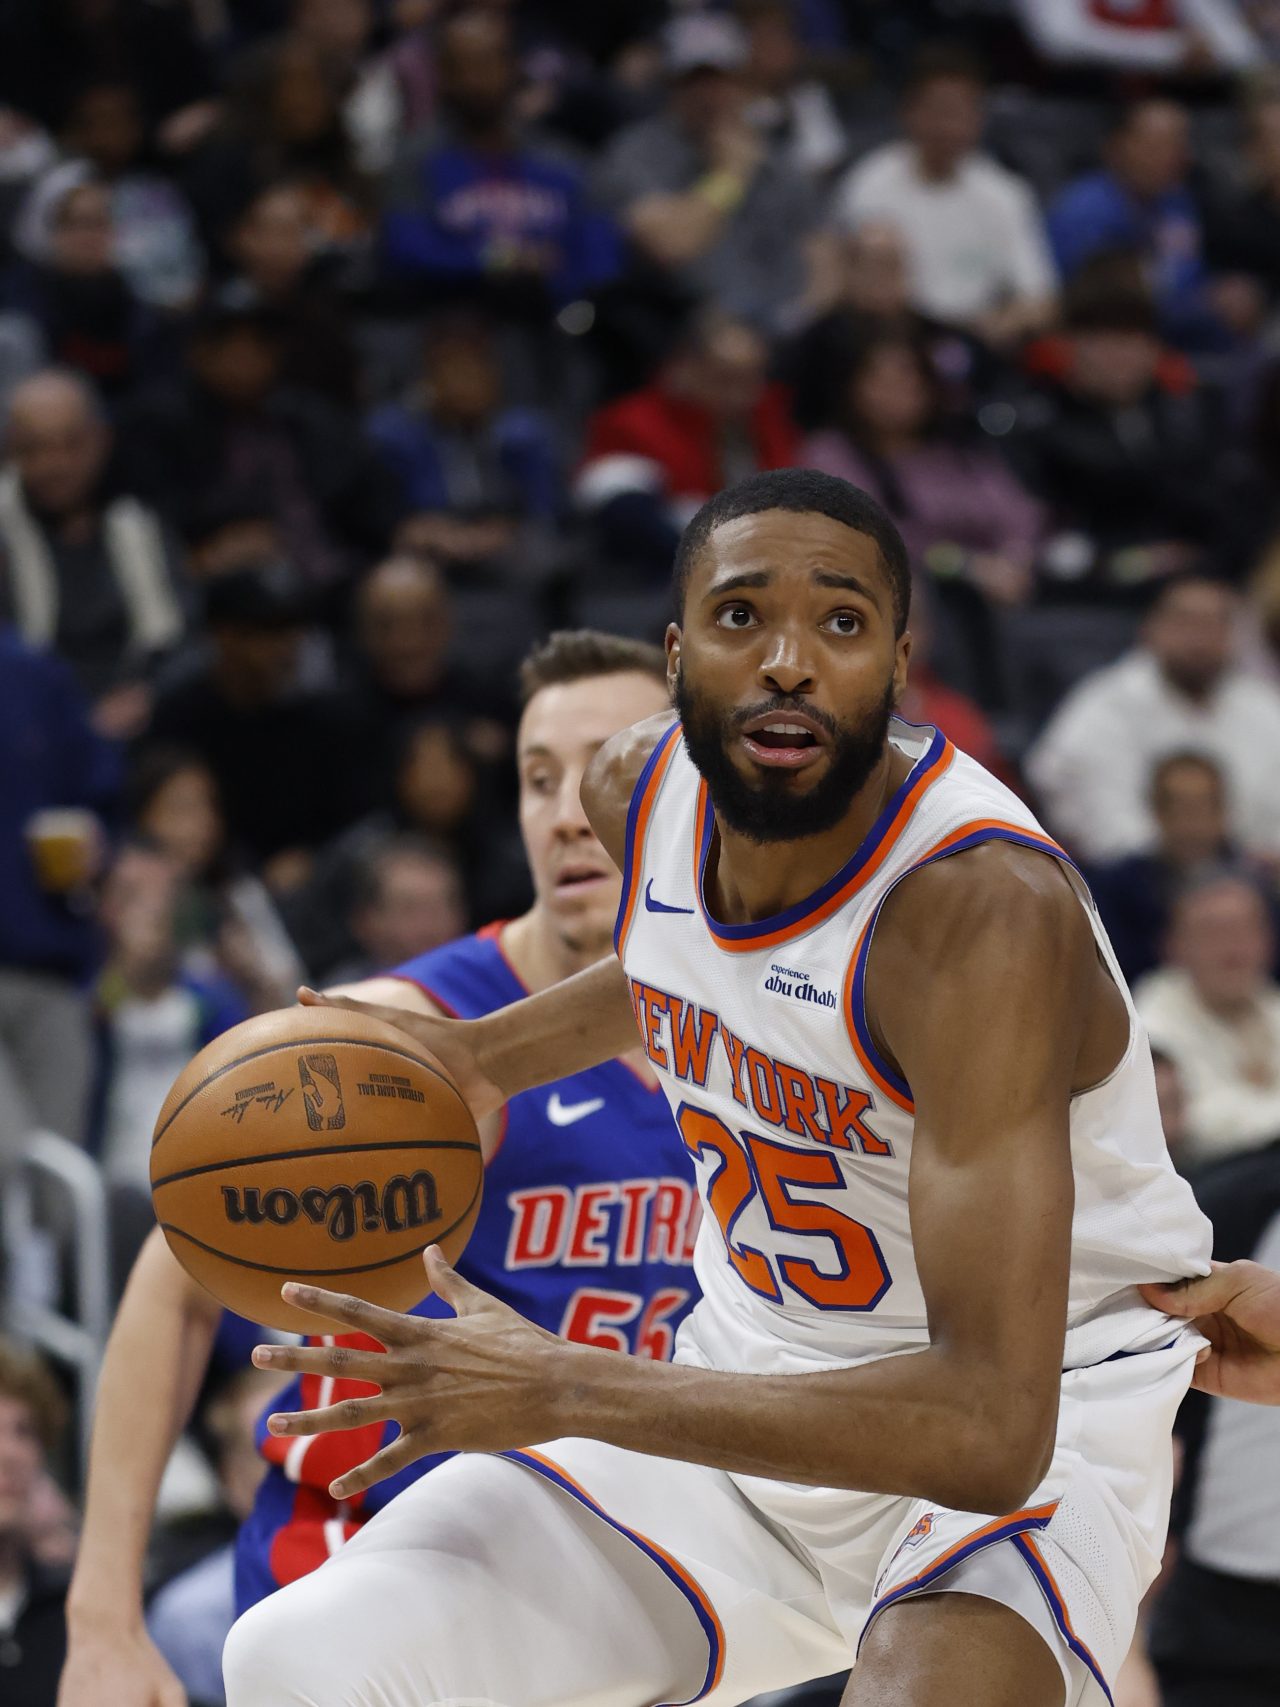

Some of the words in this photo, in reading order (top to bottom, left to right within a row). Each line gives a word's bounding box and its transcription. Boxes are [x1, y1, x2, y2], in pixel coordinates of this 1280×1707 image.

[764, 975, 793, 997] abu
[794, 983, 838, 1010] dhabi
[770, 963, 810, 981] experience
[720, 1020, 897, 1160] YORK
[221, 1169, 443, 1242] Wilson
[675, 1100, 893, 1312] 25
